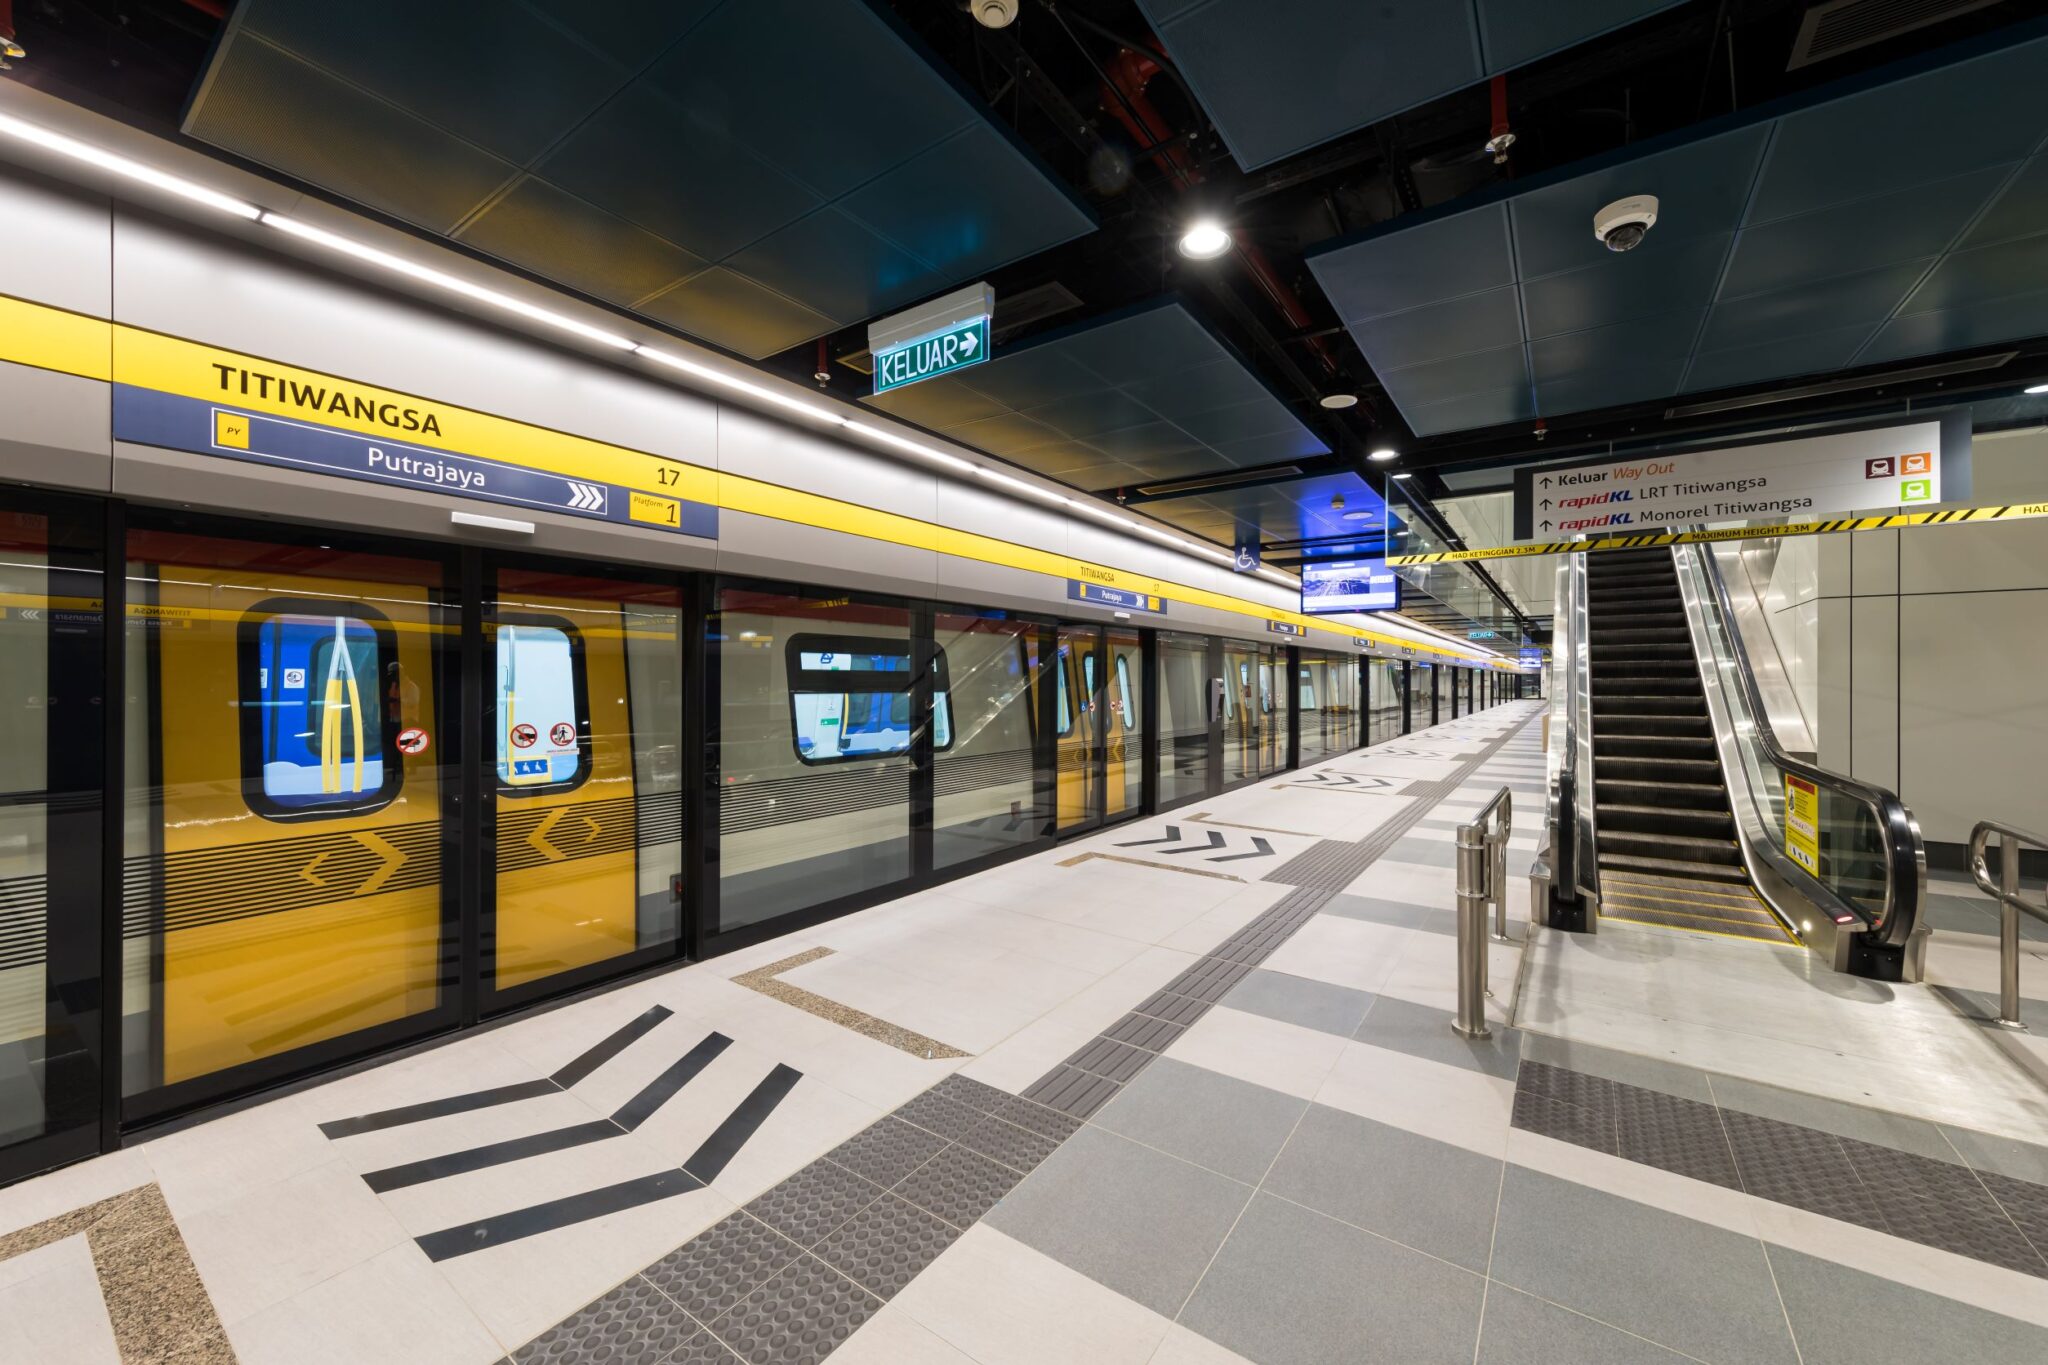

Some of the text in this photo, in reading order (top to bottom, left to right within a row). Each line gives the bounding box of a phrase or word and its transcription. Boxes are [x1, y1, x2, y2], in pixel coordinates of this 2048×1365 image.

[881, 335, 958, 386] KELUAR
[211, 362, 442, 437] TITIWANGSA
[226, 427, 241, 435] PY
[368, 446, 486, 489] Putrajaya
[658, 467, 680, 486] 17
[1558, 462, 1675, 486] Keluar Way Out
[633, 496, 663, 507] Platform
[1558, 477, 1768, 509] rapidKL LRT Titiwangsa
[666, 503, 677, 524] 1
[1558, 497, 1813, 531] rapidKL Monorel Titiwangsa
[1691, 525, 1810, 541] MAXIMUM HEIGHT 2.3M
[1452, 547, 1536, 560] HAD KETINGGIAN 2.3M
[1080, 566, 1115, 582] TITIWANGSA
[1101, 590, 1123, 604] Putrajaya
